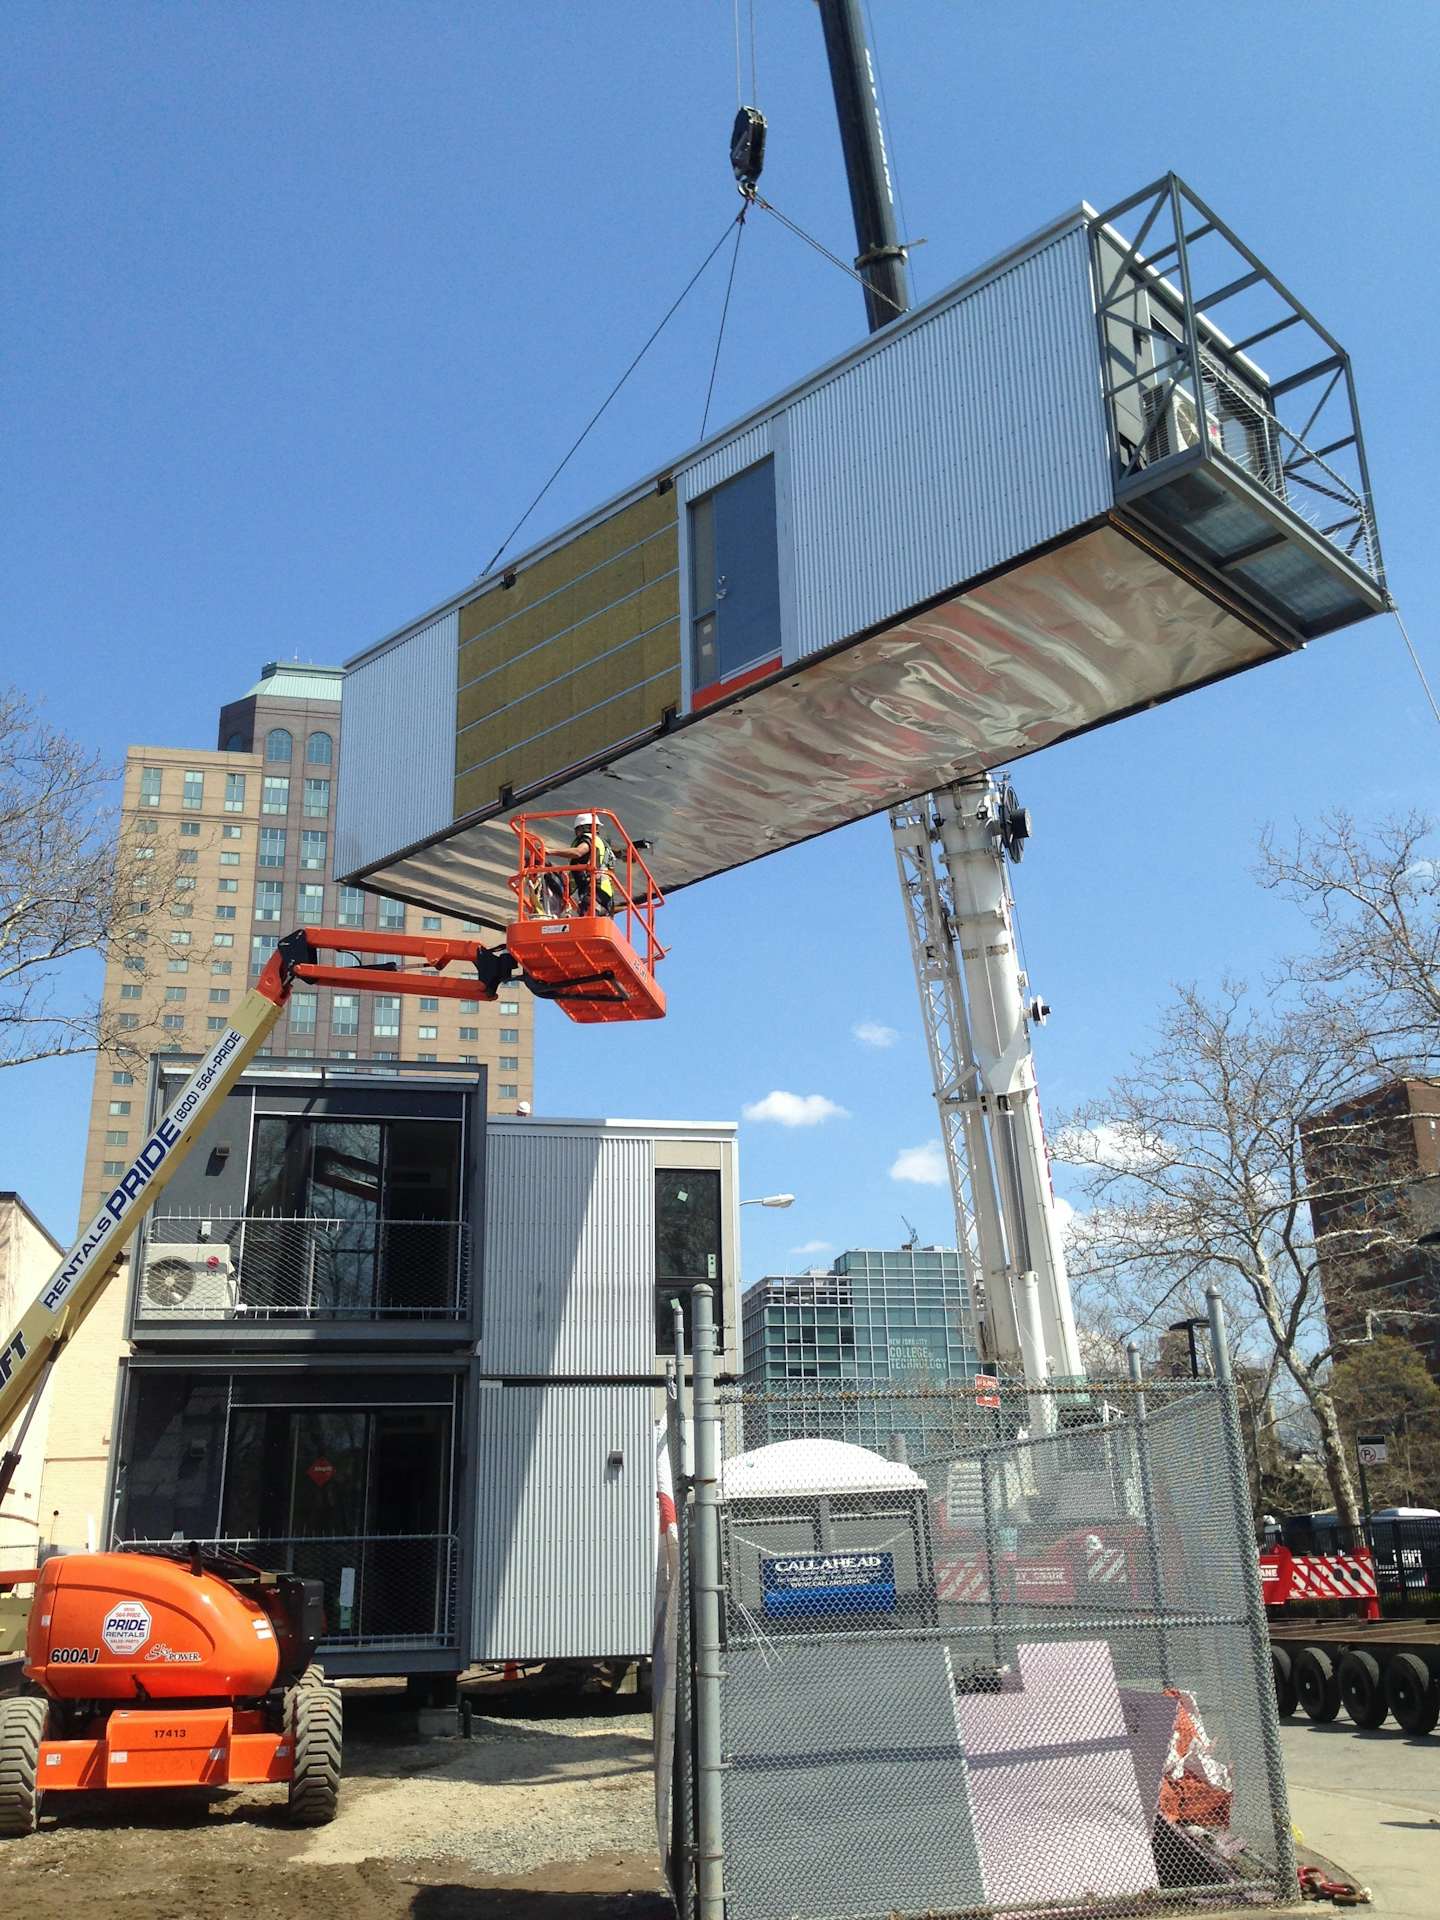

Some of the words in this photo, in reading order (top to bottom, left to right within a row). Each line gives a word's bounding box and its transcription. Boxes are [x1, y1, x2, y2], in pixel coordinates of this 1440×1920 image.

[44, 1216, 111, 1311] RENTALS
[106, 1119, 181, 1220] PRIDE
[174, 1092, 200, 1122] (800)
[196, 1031, 241, 1093] 564-PRIDE
[889, 1346, 928, 1358] COLLEGE
[889, 1358, 947, 1369] TECHNOLOGY
[775, 1557, 881, 1571] CALLAHEAD
[1261, 1568, 1278, 1577] ANE
[106, 1619, 148, 1631] PRIDE
[51, 1649, 98, 1663] 600AJ
[168, 1652, 199, 1661] POWER
[154, 1729, 187, 1739] 17413
